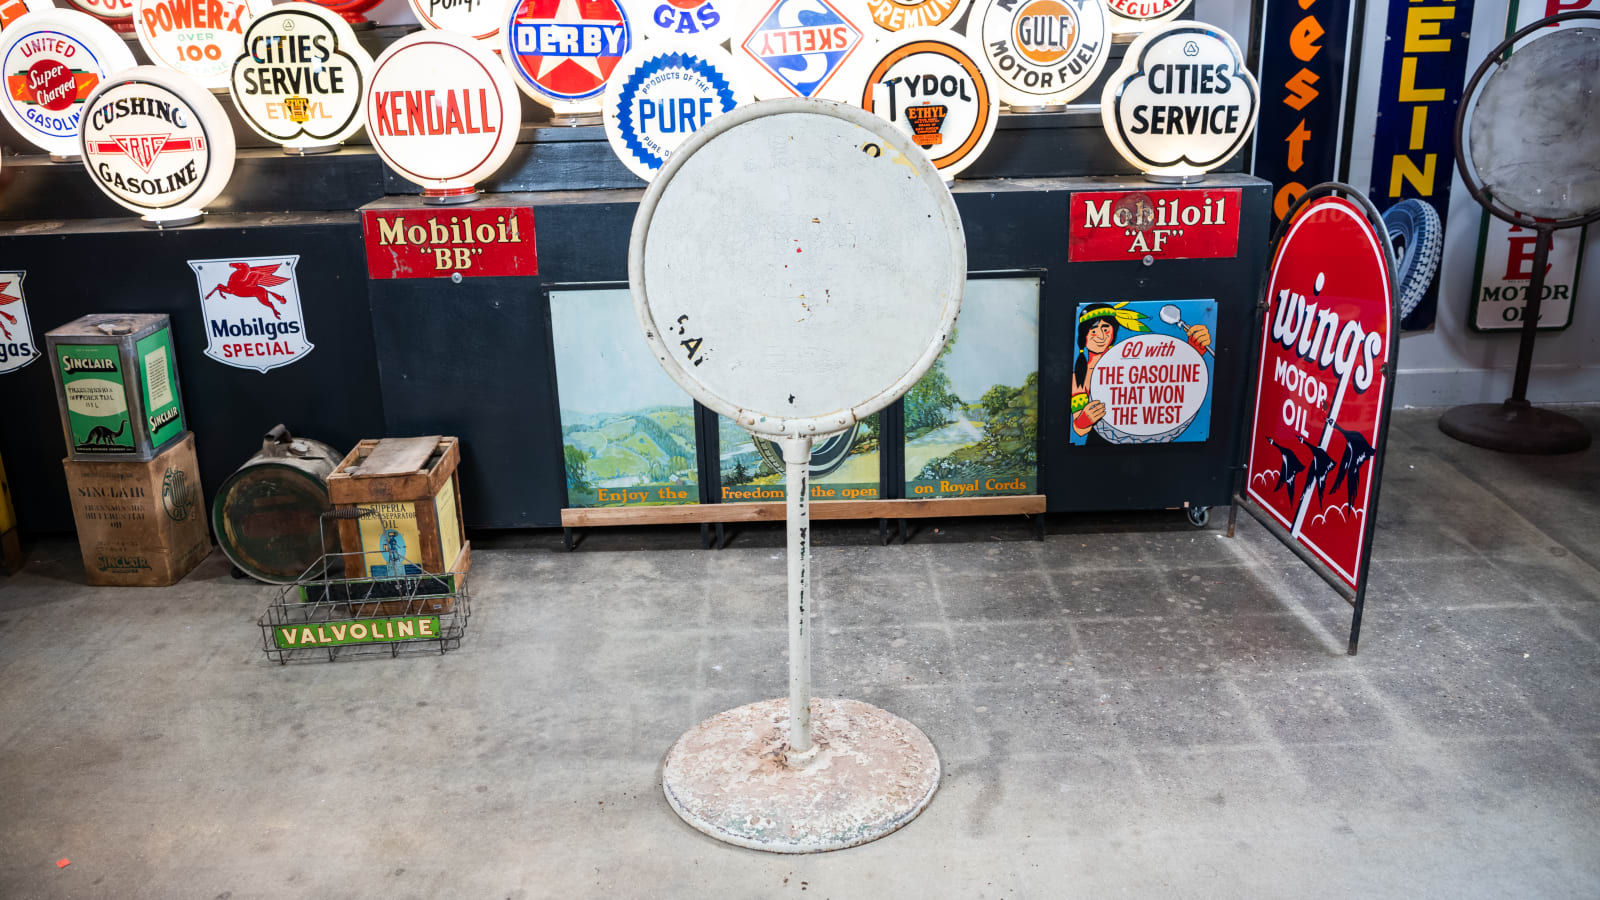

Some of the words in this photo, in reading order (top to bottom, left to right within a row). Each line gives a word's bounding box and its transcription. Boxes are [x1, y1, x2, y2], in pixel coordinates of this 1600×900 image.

[142, 0, 246, 38] POWER-X
[653, 3, 720, 34] GAS
[867, 0, 953, 28] REMIU
[177, 32, 214, 42] OVER
[517, 26, 623, 54] DERBY
[761, 27, 848, 56] SKELLY
[1019, 16, 1069, 50] GULF
[20, 38, 76, 58] UNITED
[176, 44, 222, 62] 100
[252, 35, 330, 64] CITIES
[29, 65, 65, 90] Super
[990, 39, 1053, 88] MOTOR
[1058, 41, 1098, 84] FUEL
[36, 76, 76, 106] Charged
[243, 66, 344, 95] SERVICE
[642, 72, 680, 95] PRODUCTS
[683, 73, 694, 81] OF
[695, 78, 710, 93] THE
[1149, 64, 1232, 95] CITIES
[266, 102, 333, 120] ETHYL
[375, 88, 496, 136] KENDALL
[883, 75, 972, 122] TYDOL
[1389, 0, 1456, 198] ELIN
[26, 106, 83, 131] GASOLIN
[92, 97, 187, 131] CUSHING
[908, 106, 946, 120] ETHYL
[1130, 105, 1240, 135] SERVICE
[643, 136, 662, 154] PURE
[99, 158, 198, 195] GASOLINE
[1083, 196, 1226, 229] Mobiloil
[376, 214, 522, 246] Mobiloil
[211, 316, 301, 341] Mobilgas
[223, 341, 296, 359] SPECIAL
[1121, 341, 1144, 358] GO
[1145, 340, 1176, 358] with
[1273, 272, 1382, 450] wings
[62, 355, 115, 373] SINCLAIR
[1097, 366, 1125, 386] THE
[1128, 363, 1201, 385] GASOLINE
[1109, 386, 1145, 406] THAT
[1148, 384, 1185, 405] WON
[1274, 356, 1328, 410] MOTOR
[149, 406, 178, 432] SINCLAIR
[1111, 406, 1138, 426] THE
[1142, 405, 1183, 425] WEST
[1282, 399, 1310, 439] OIL
[597, 487, 650, 503] Enjoy
[658, 487, 688, 500] the
[721, 486, 785, 499] Freedom
[811, 486, 835, 498] the
[841, 488, 878, 500] open
[914, 485, 934, 494] on
[940, 480, 979, 496] Royal
[985, 478, 1027, 491] Cords
[383, 520, 399, 529] OIL
[281, 617, 433, 645] VALVOLINE
